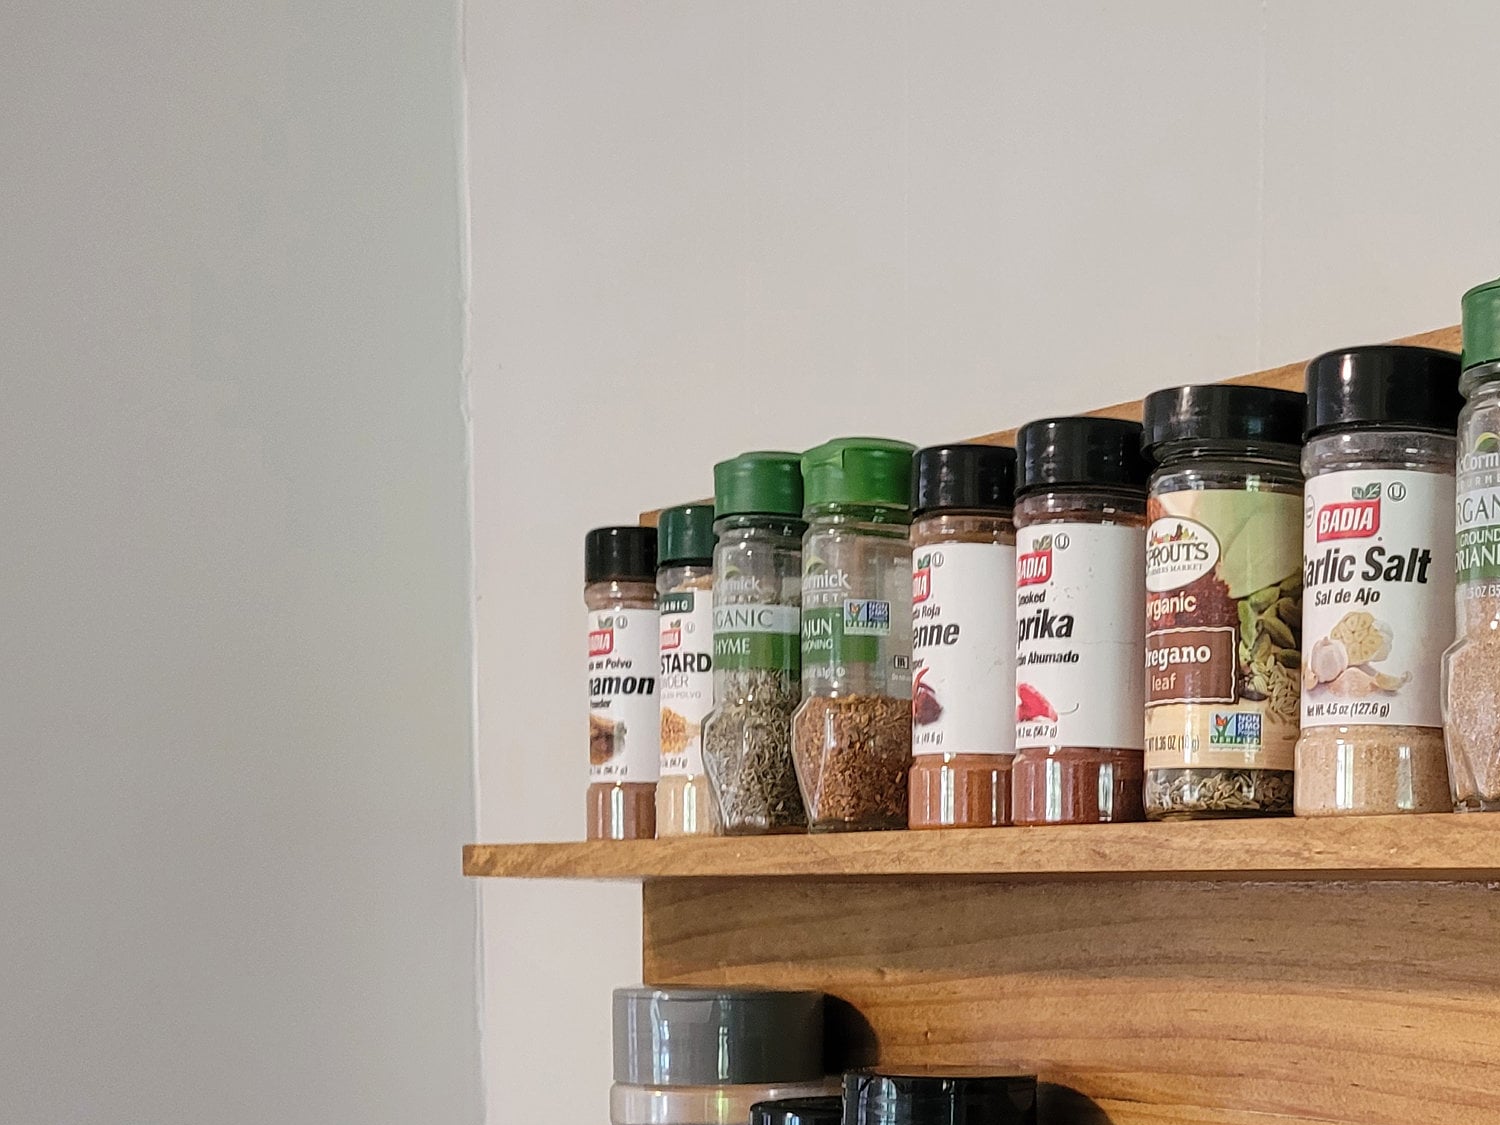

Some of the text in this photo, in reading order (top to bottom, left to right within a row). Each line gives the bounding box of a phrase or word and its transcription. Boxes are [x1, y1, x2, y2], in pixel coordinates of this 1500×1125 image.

[1319, 506, 1374, 535] BADIA
[1147, 542, 1209, 568] PROUTS
[1362, 546, 1432, 584] Salt
[1315, 588, 1380, 607] Sal de Ajo
[1475, 585, 1487, 597] OZ
[803, 617, 832, 637] AJUN
[913, 622, 960, 649] enne
[1018, 609, 1075, 650] prika
[716, 638, 750, 656] HYME
[605, 660, 632, 669] Polvo
[1028, 650, 1079, 665] Ahumado
[1146, 645, 1211, 671] regano
[1152, 673, 1176, 692] leaf
[1238, 714, 1260, 722] NON
[1327, 703, 1337, 716] 4.5
[1339, 705, 1348, 715] oz
[1350, 702, 1378, 717] (127.6
[1380, 703, 1390, 718] g)
